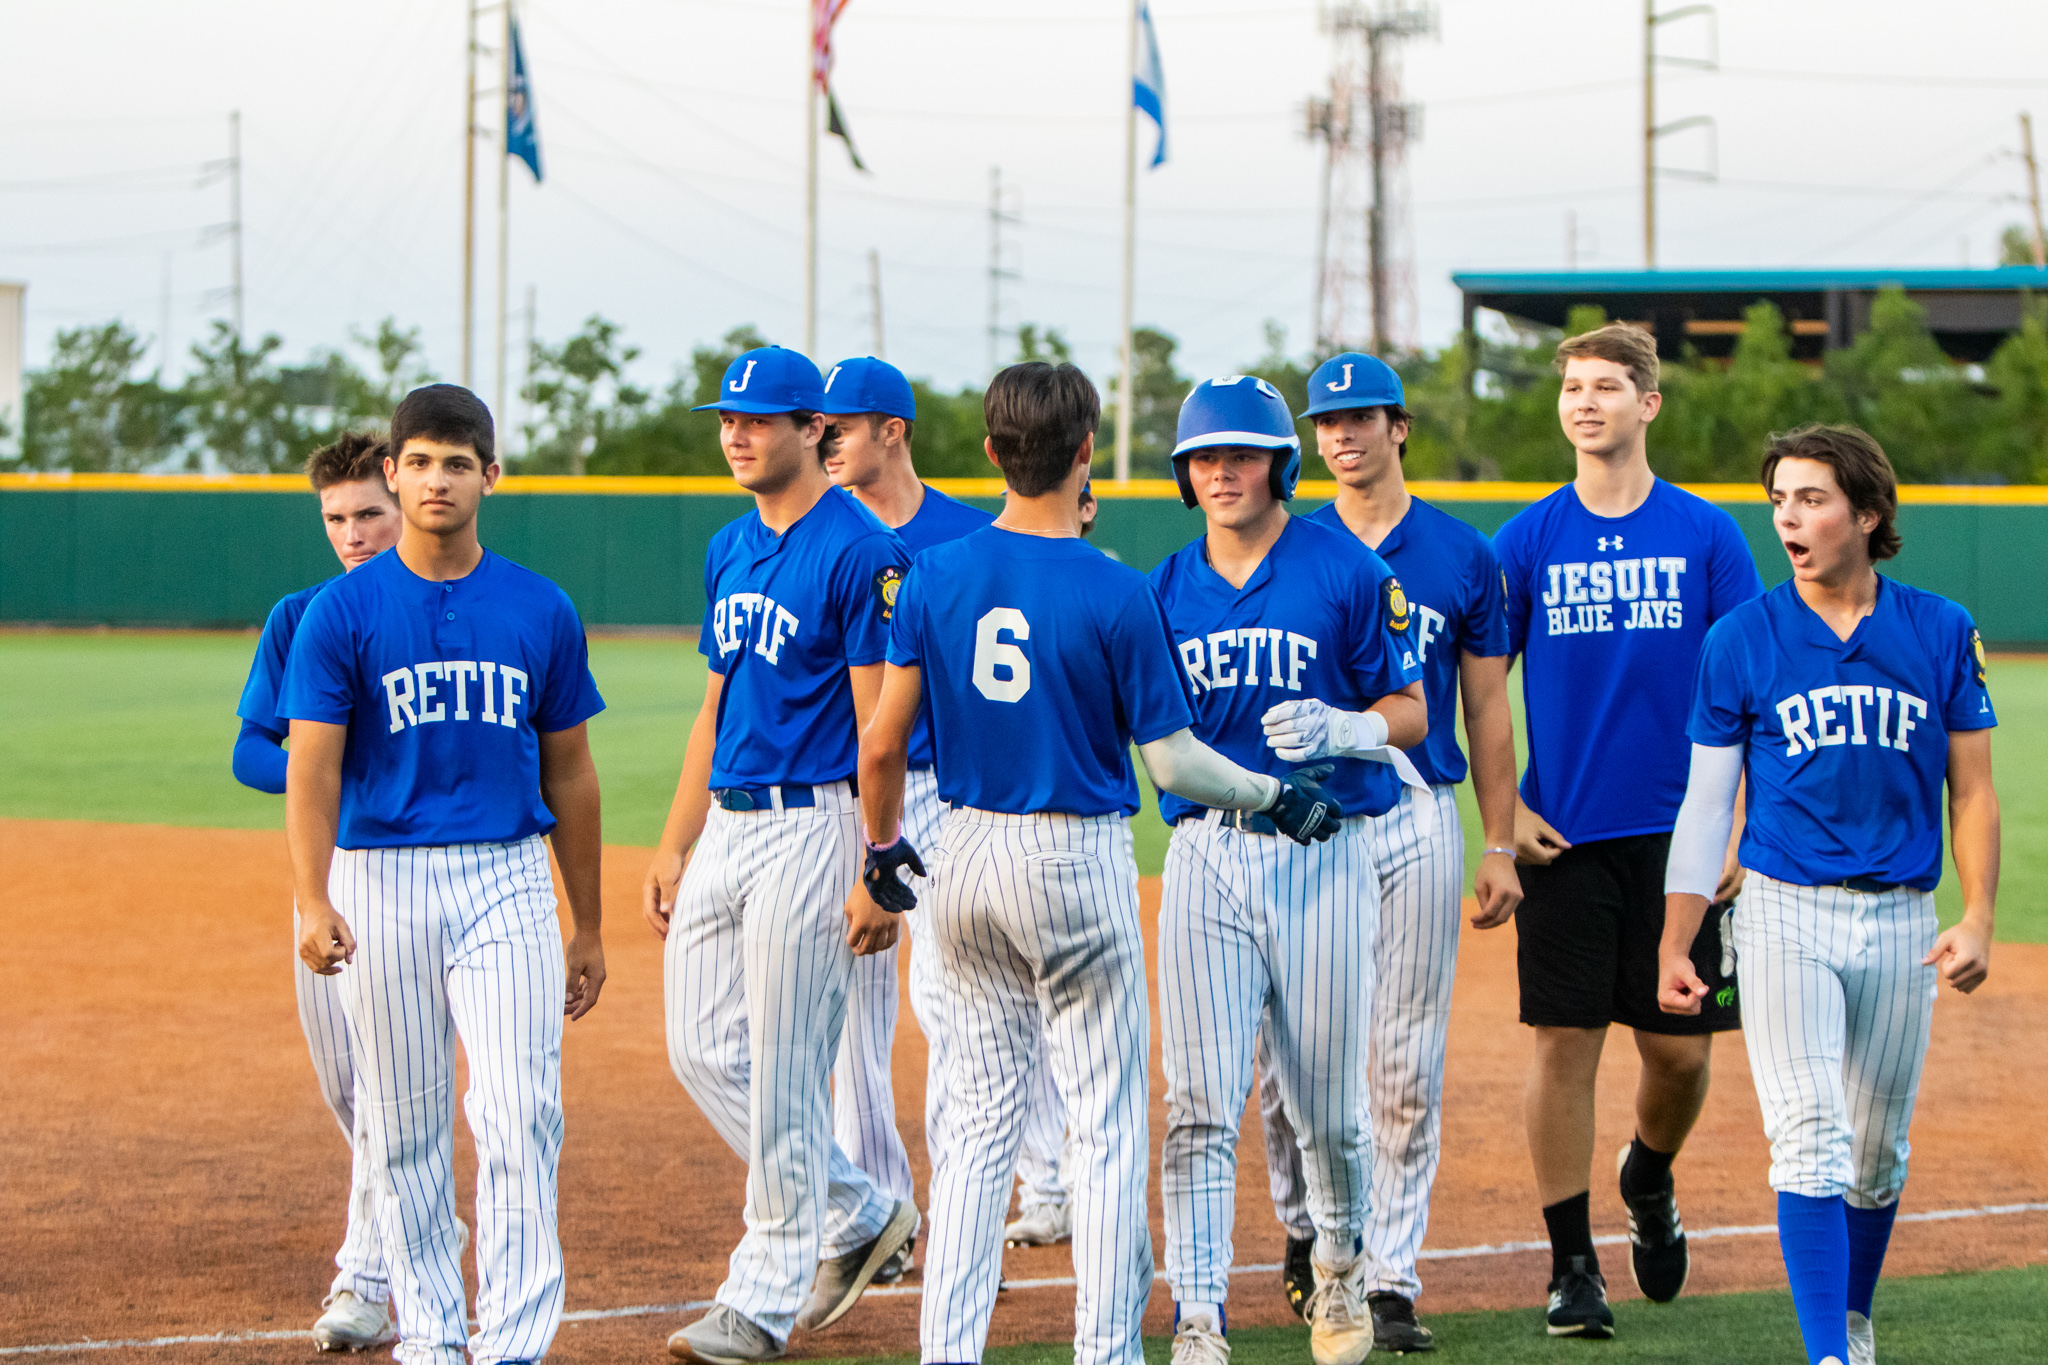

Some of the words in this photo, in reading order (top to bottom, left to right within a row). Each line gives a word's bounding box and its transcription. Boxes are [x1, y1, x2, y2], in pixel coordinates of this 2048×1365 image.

[729, 360, 757, 392] J
[1326, 363, 1354, 392] J
[1542, 557, 1687, 607] JESUIT
[713, 592, 799, 666] RETIF
[1547, 604, 1614, 636] BLUE
[1624, 600, 1683, 630] JAYS
[972, 607, 1030, 703] 6
[1178, 628, 1317, 695] RETIF
[382, 660, 528, 734] RETIF
[1775, 685, 1928, 757] RETIF
